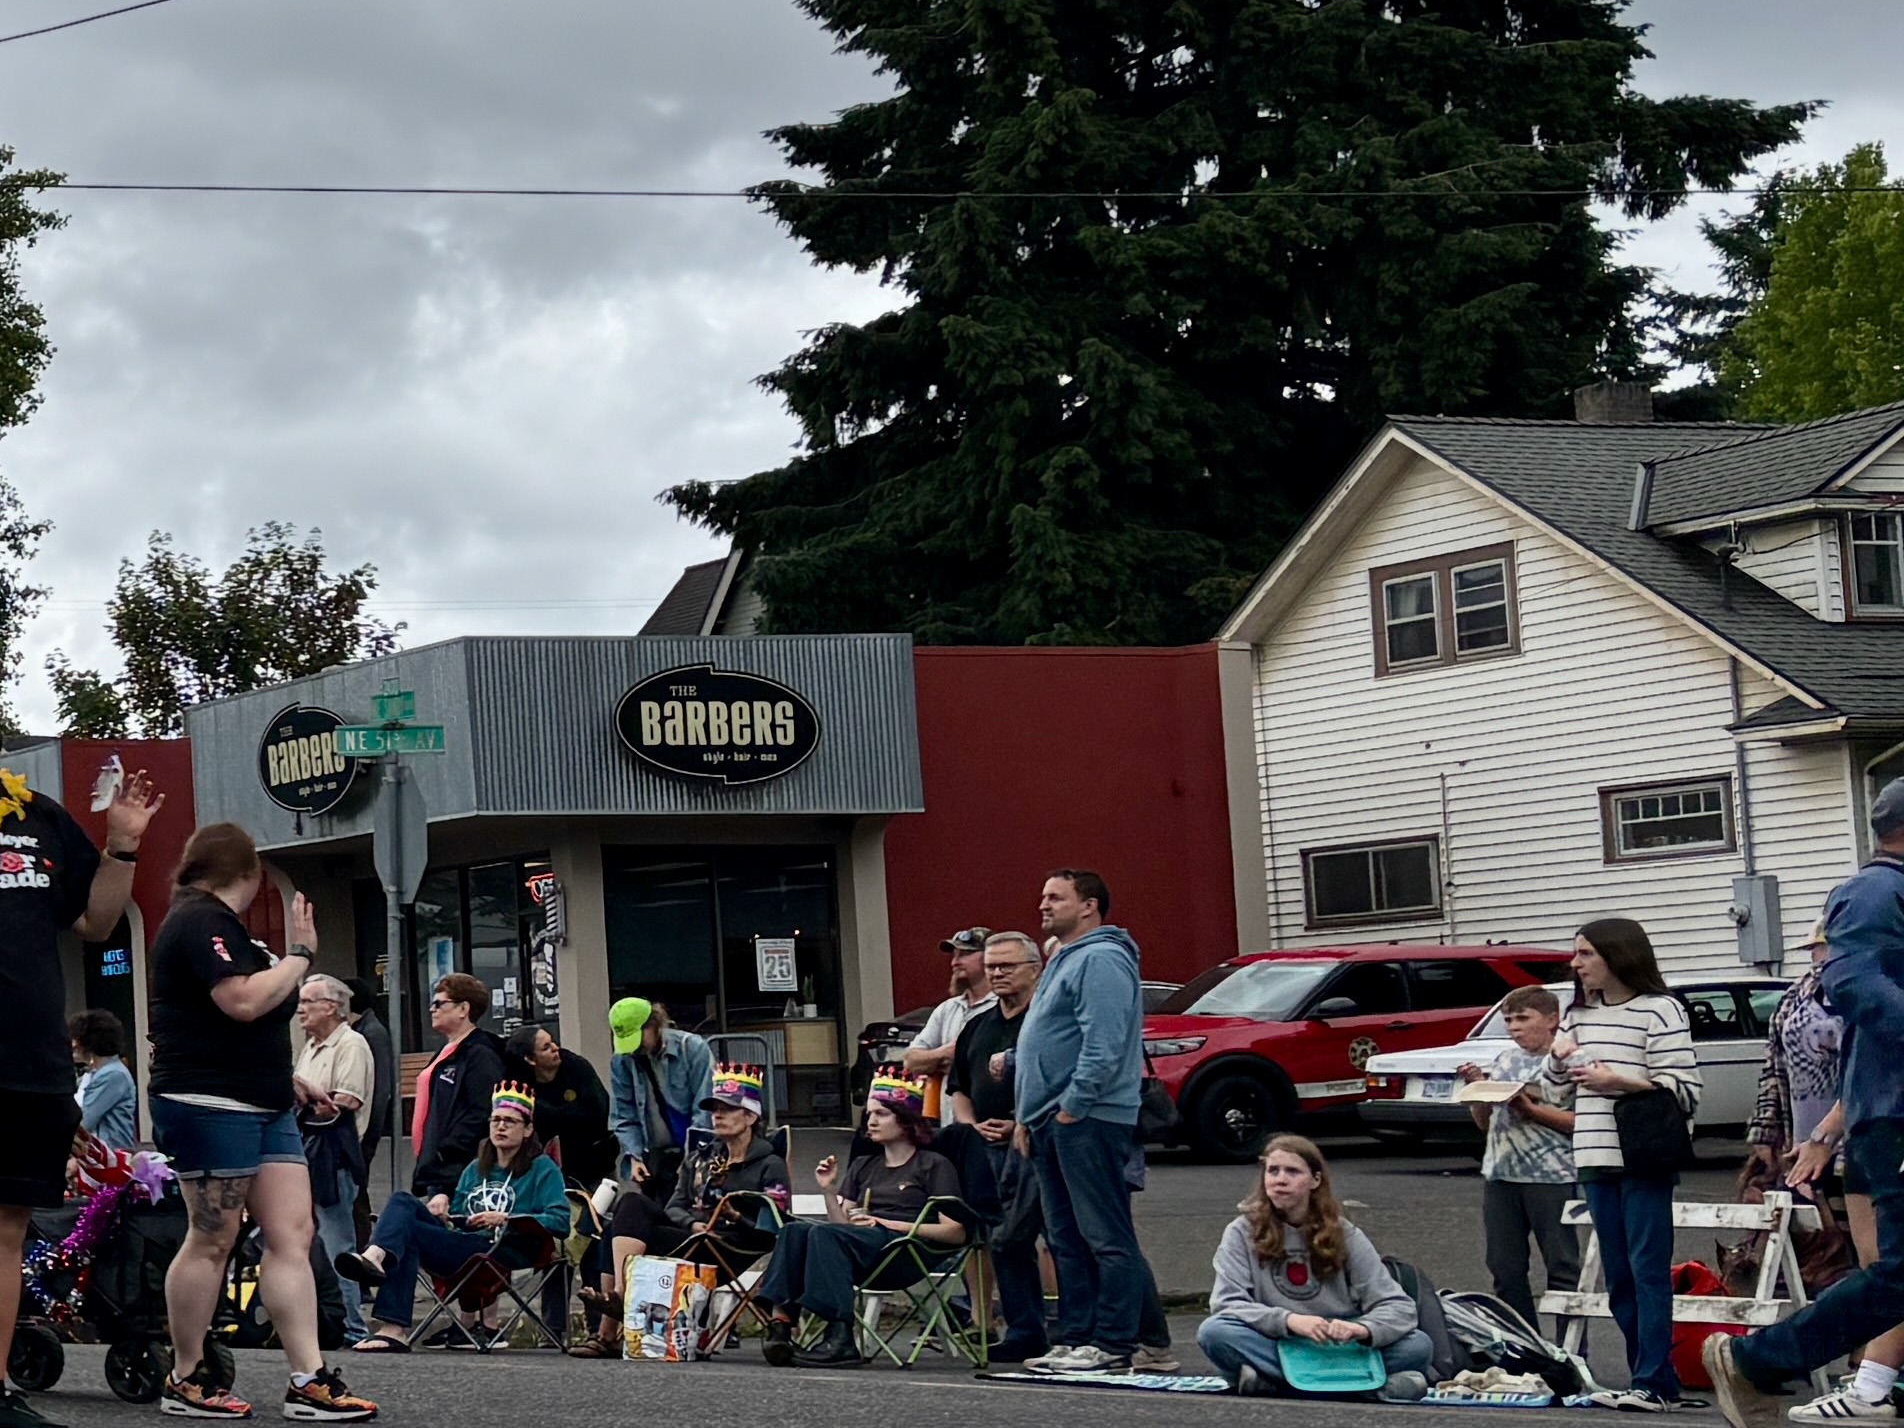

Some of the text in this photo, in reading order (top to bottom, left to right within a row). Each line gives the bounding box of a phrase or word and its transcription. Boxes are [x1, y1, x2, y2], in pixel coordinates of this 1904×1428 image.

[669, 685, 697, 697] THE
[345, 731, 367, 750] NE
[415, 731, 436, 750] AV
[765, 954, 791, 979] 25
